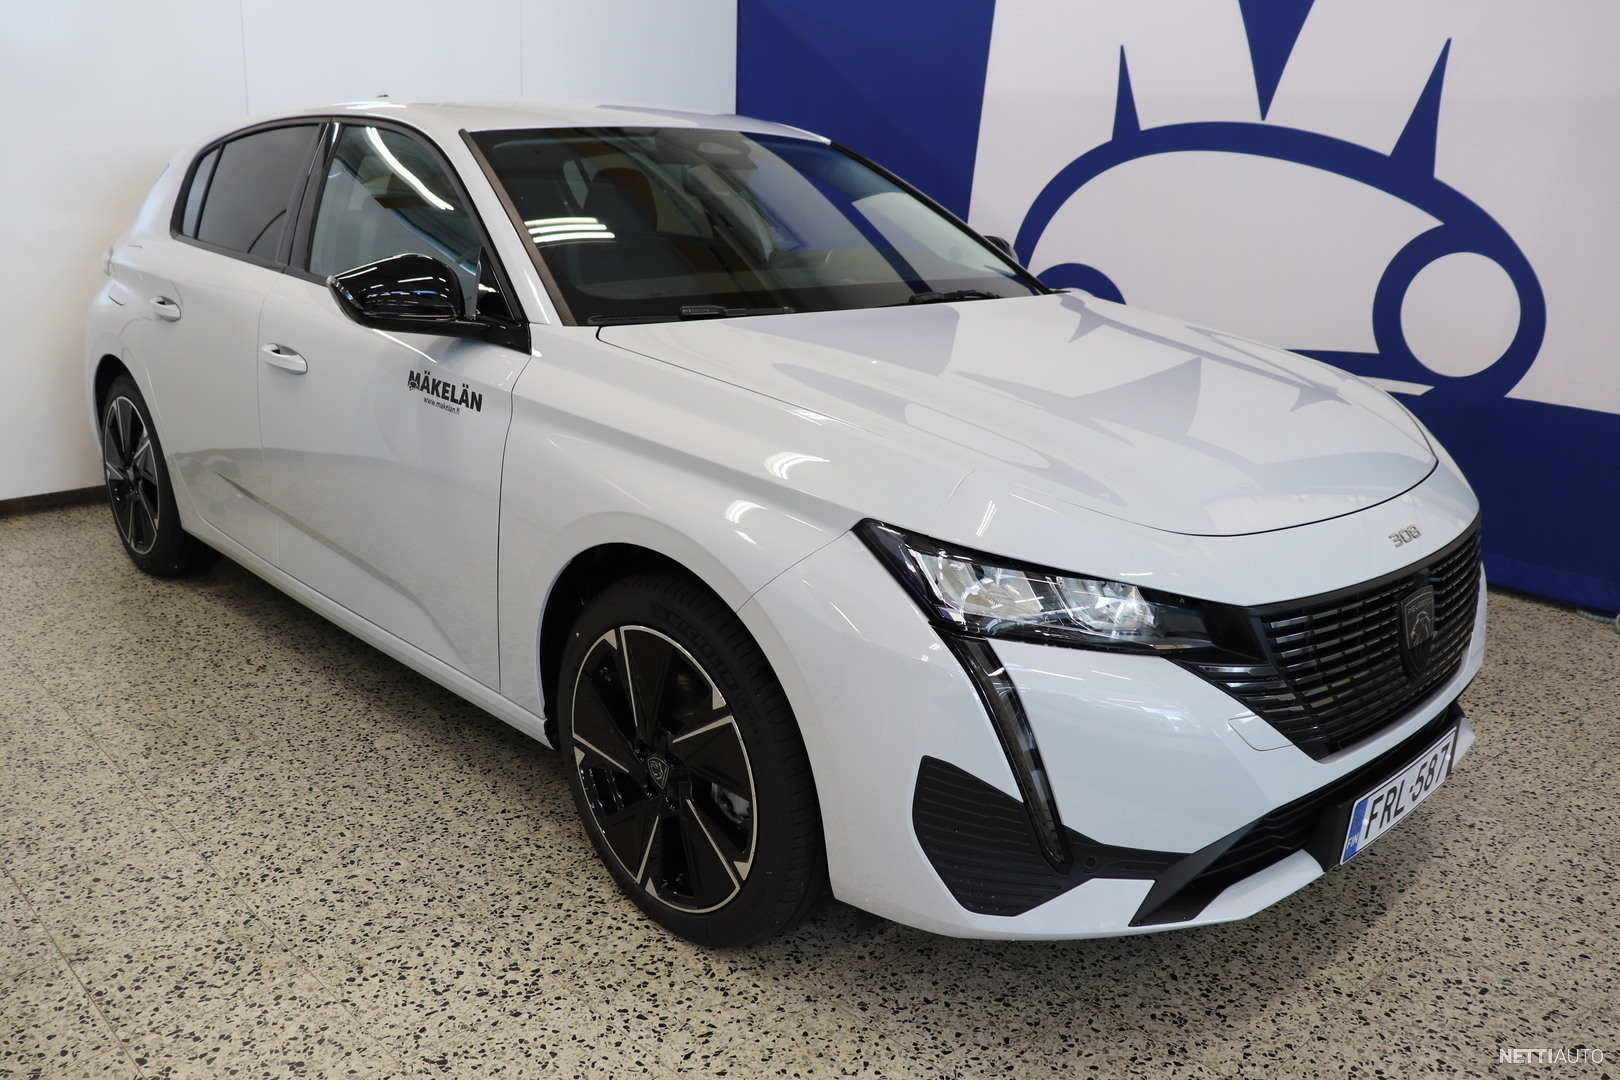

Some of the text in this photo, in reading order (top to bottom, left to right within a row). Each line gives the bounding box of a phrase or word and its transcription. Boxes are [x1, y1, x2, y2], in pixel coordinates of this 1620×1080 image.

[407, 370, 482, 412] MÄKELÄN
[423, 397, 460, 415] www.makelan.fi
[1388, 525, 1421, 548] 308
[1364, 742, 1450, 839] FRL-587
